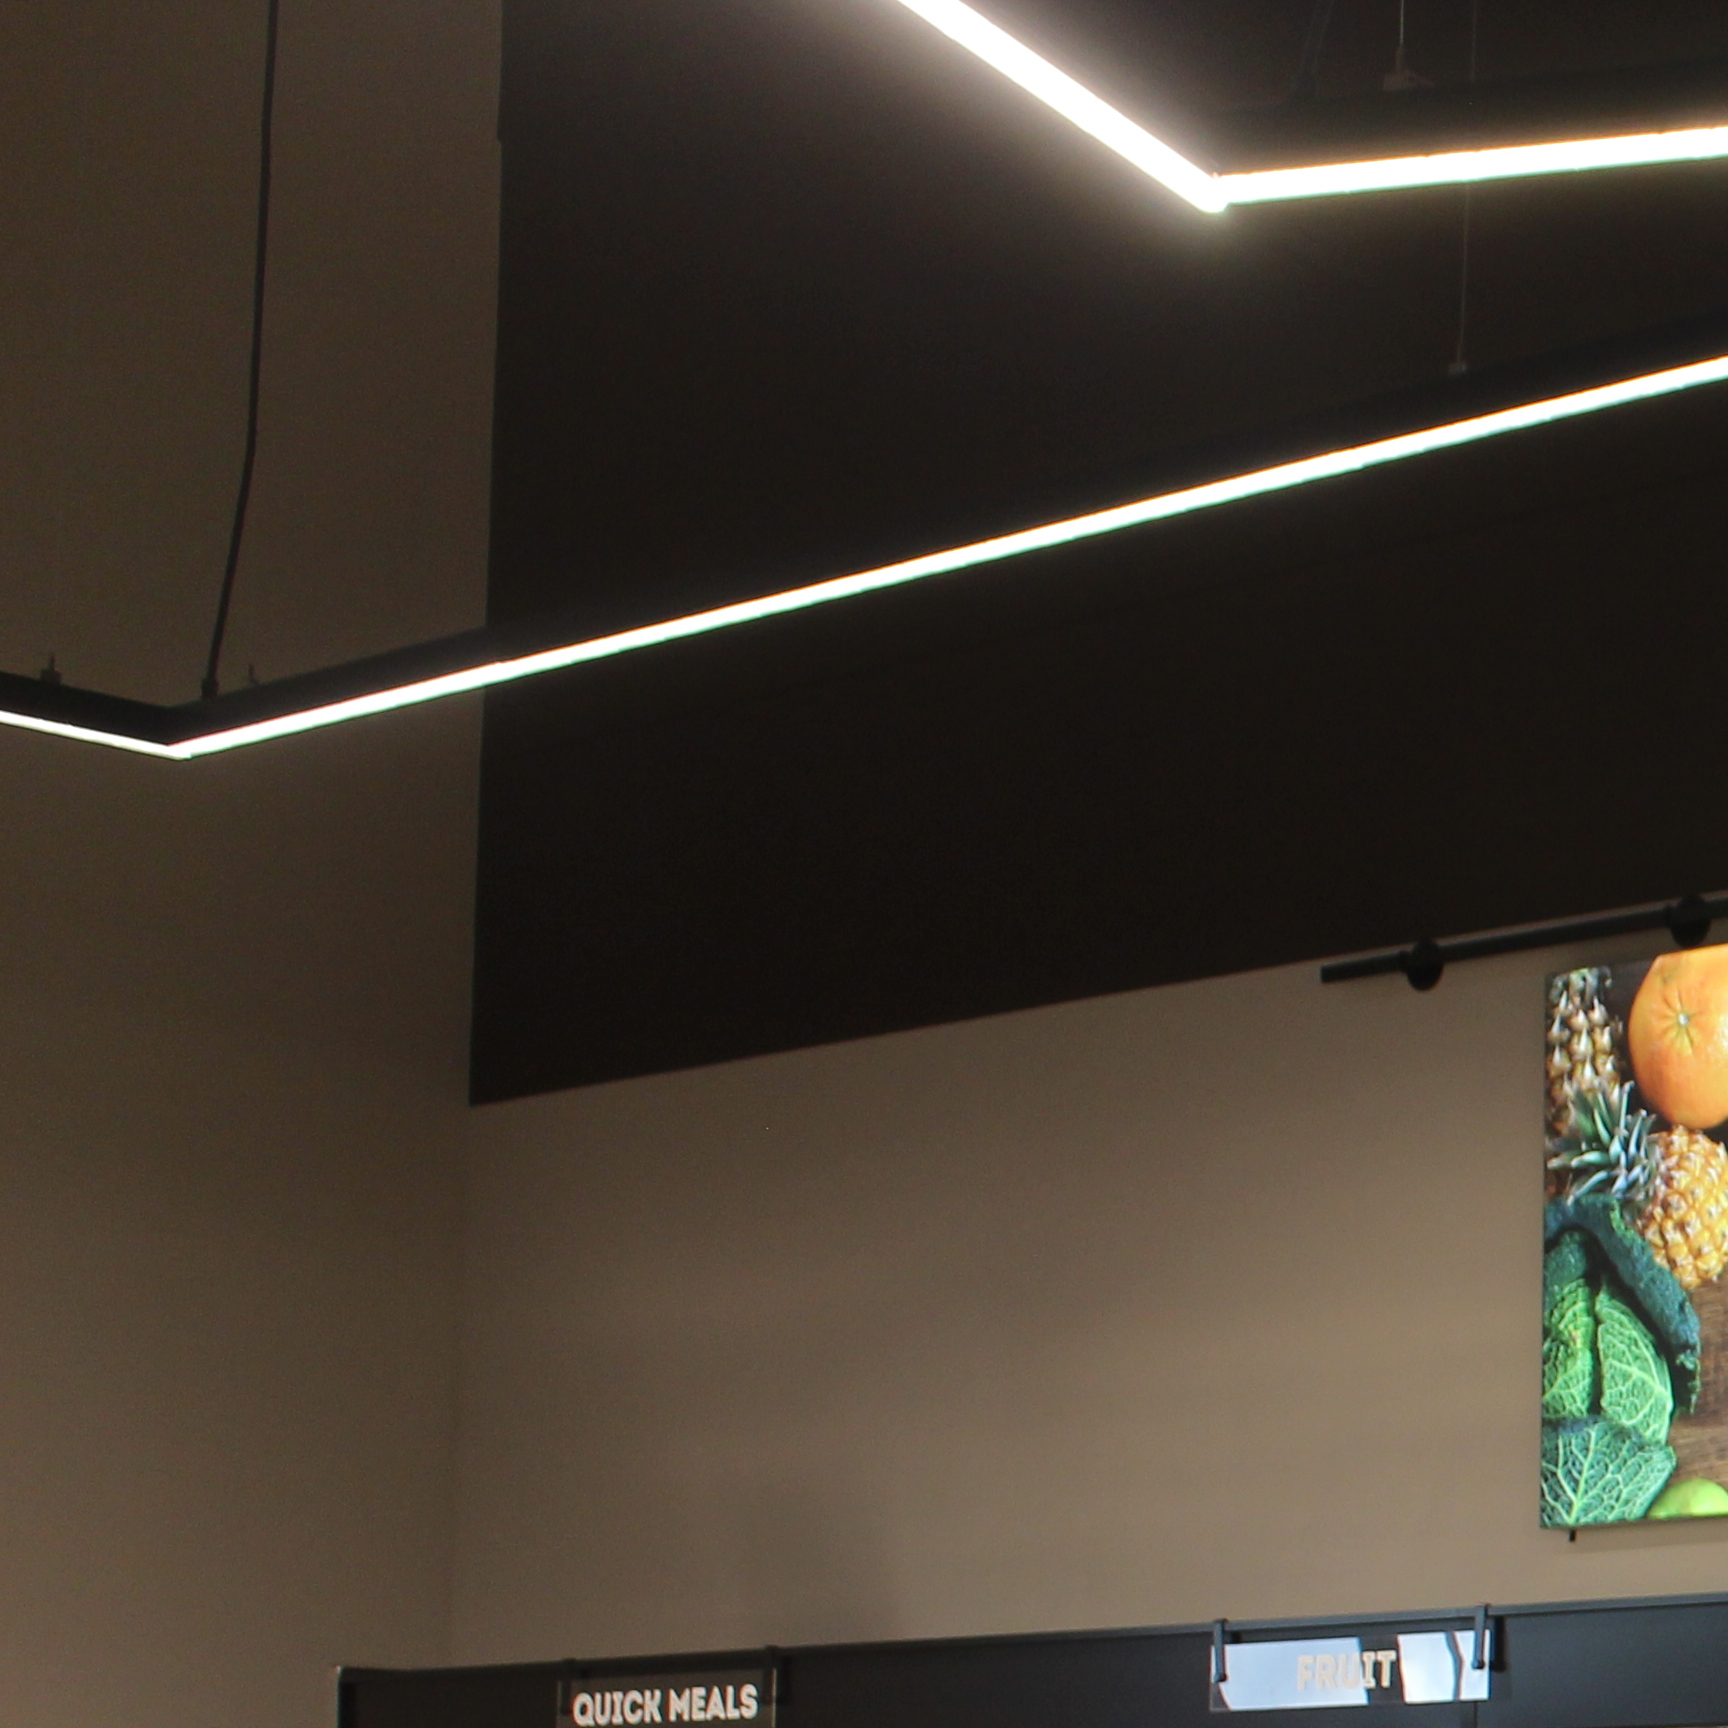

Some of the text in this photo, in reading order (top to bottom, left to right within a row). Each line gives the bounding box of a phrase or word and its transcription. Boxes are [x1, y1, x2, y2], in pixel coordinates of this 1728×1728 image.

[1296, 1650, 1397, 1690] FRUIT
[572, 1683, 759, 1728] QUICK MEALS
